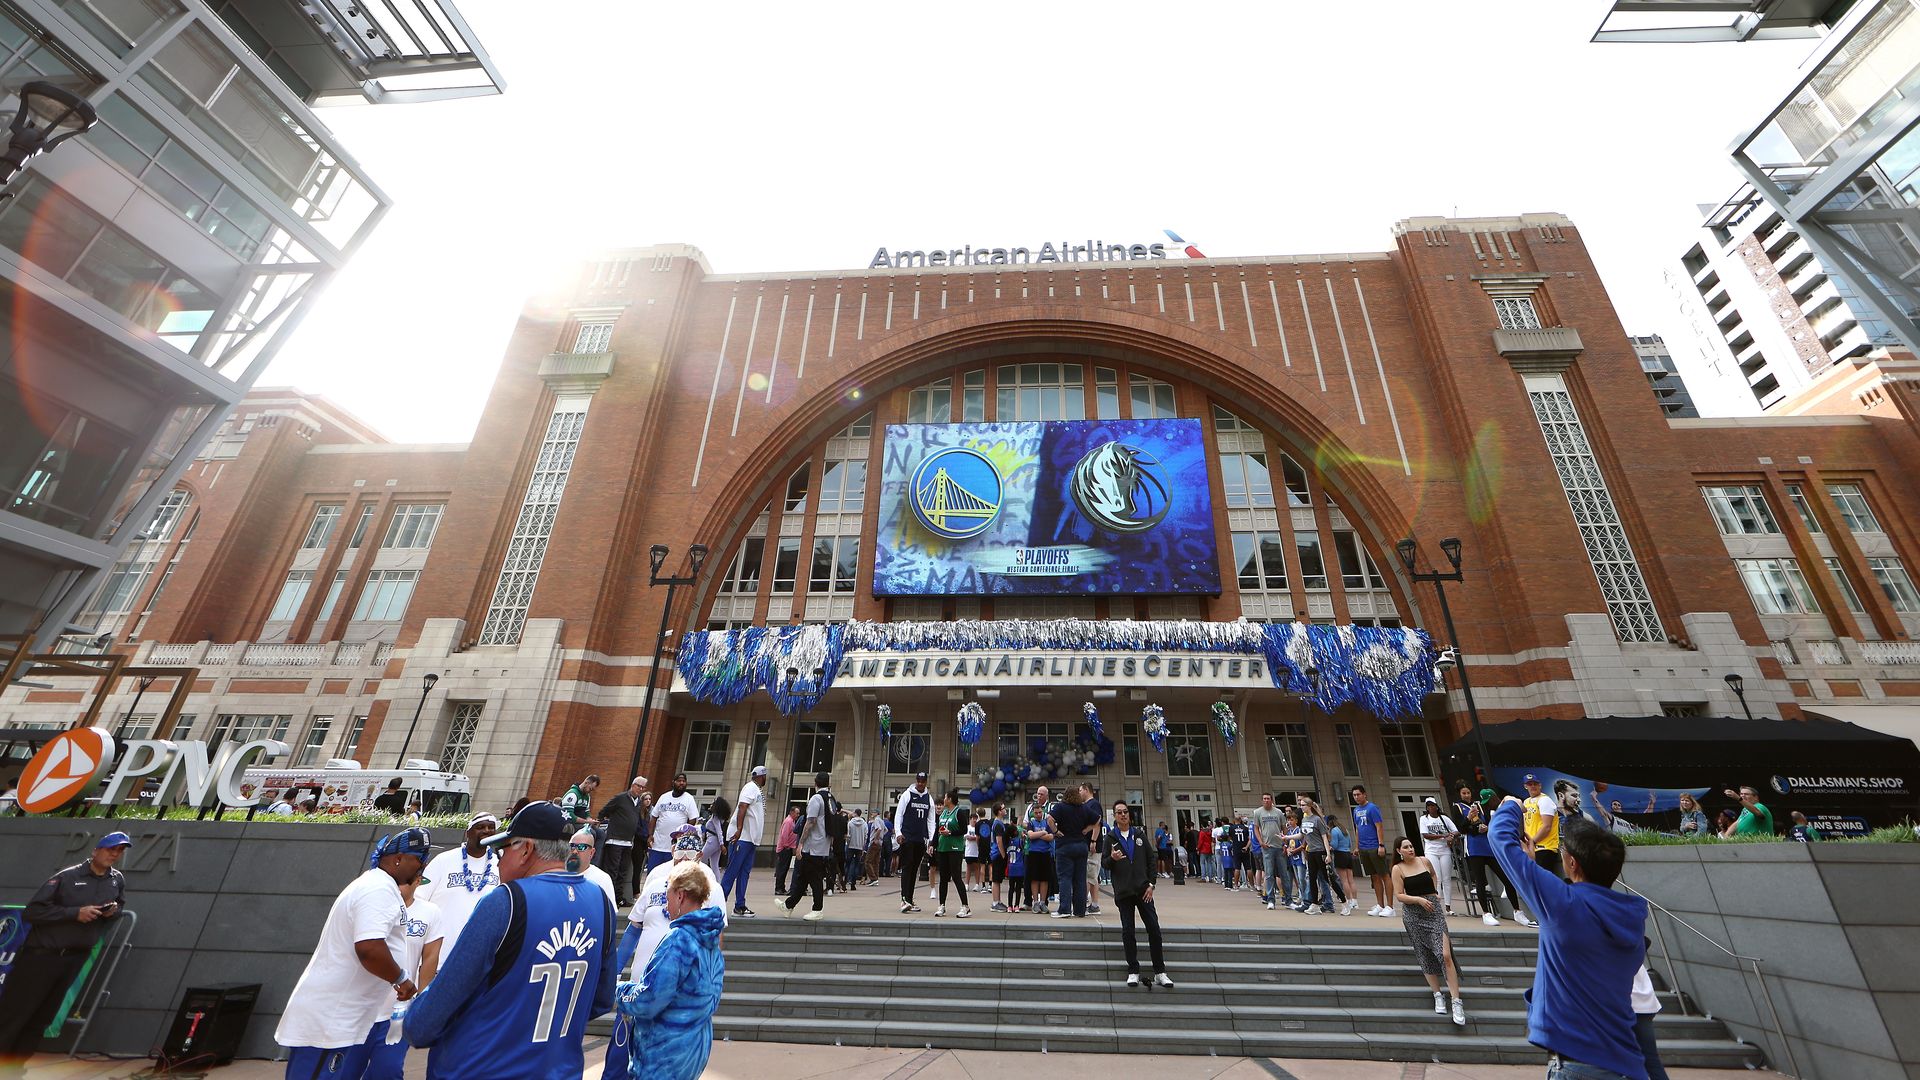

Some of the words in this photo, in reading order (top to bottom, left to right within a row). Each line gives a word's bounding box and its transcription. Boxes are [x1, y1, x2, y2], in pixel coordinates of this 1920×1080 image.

[869, 244, 1030, 269] American
[1036, 240, 1167, 265] Airlines
[1025, 549, 1069, 565] PLAYOFFS
[100, 739, 291, 807] PNC
[1788, 777, 1904, 788] DALLASMAVS.SHOP
[917, 809, 924, 818] 77
[1834, 822, 1863, 830] SWAG
[1235, 832, 1244, 841] 77
[536, 917, 597, 960] DONČIĆ
[529, 960, 588, 1043] 77
